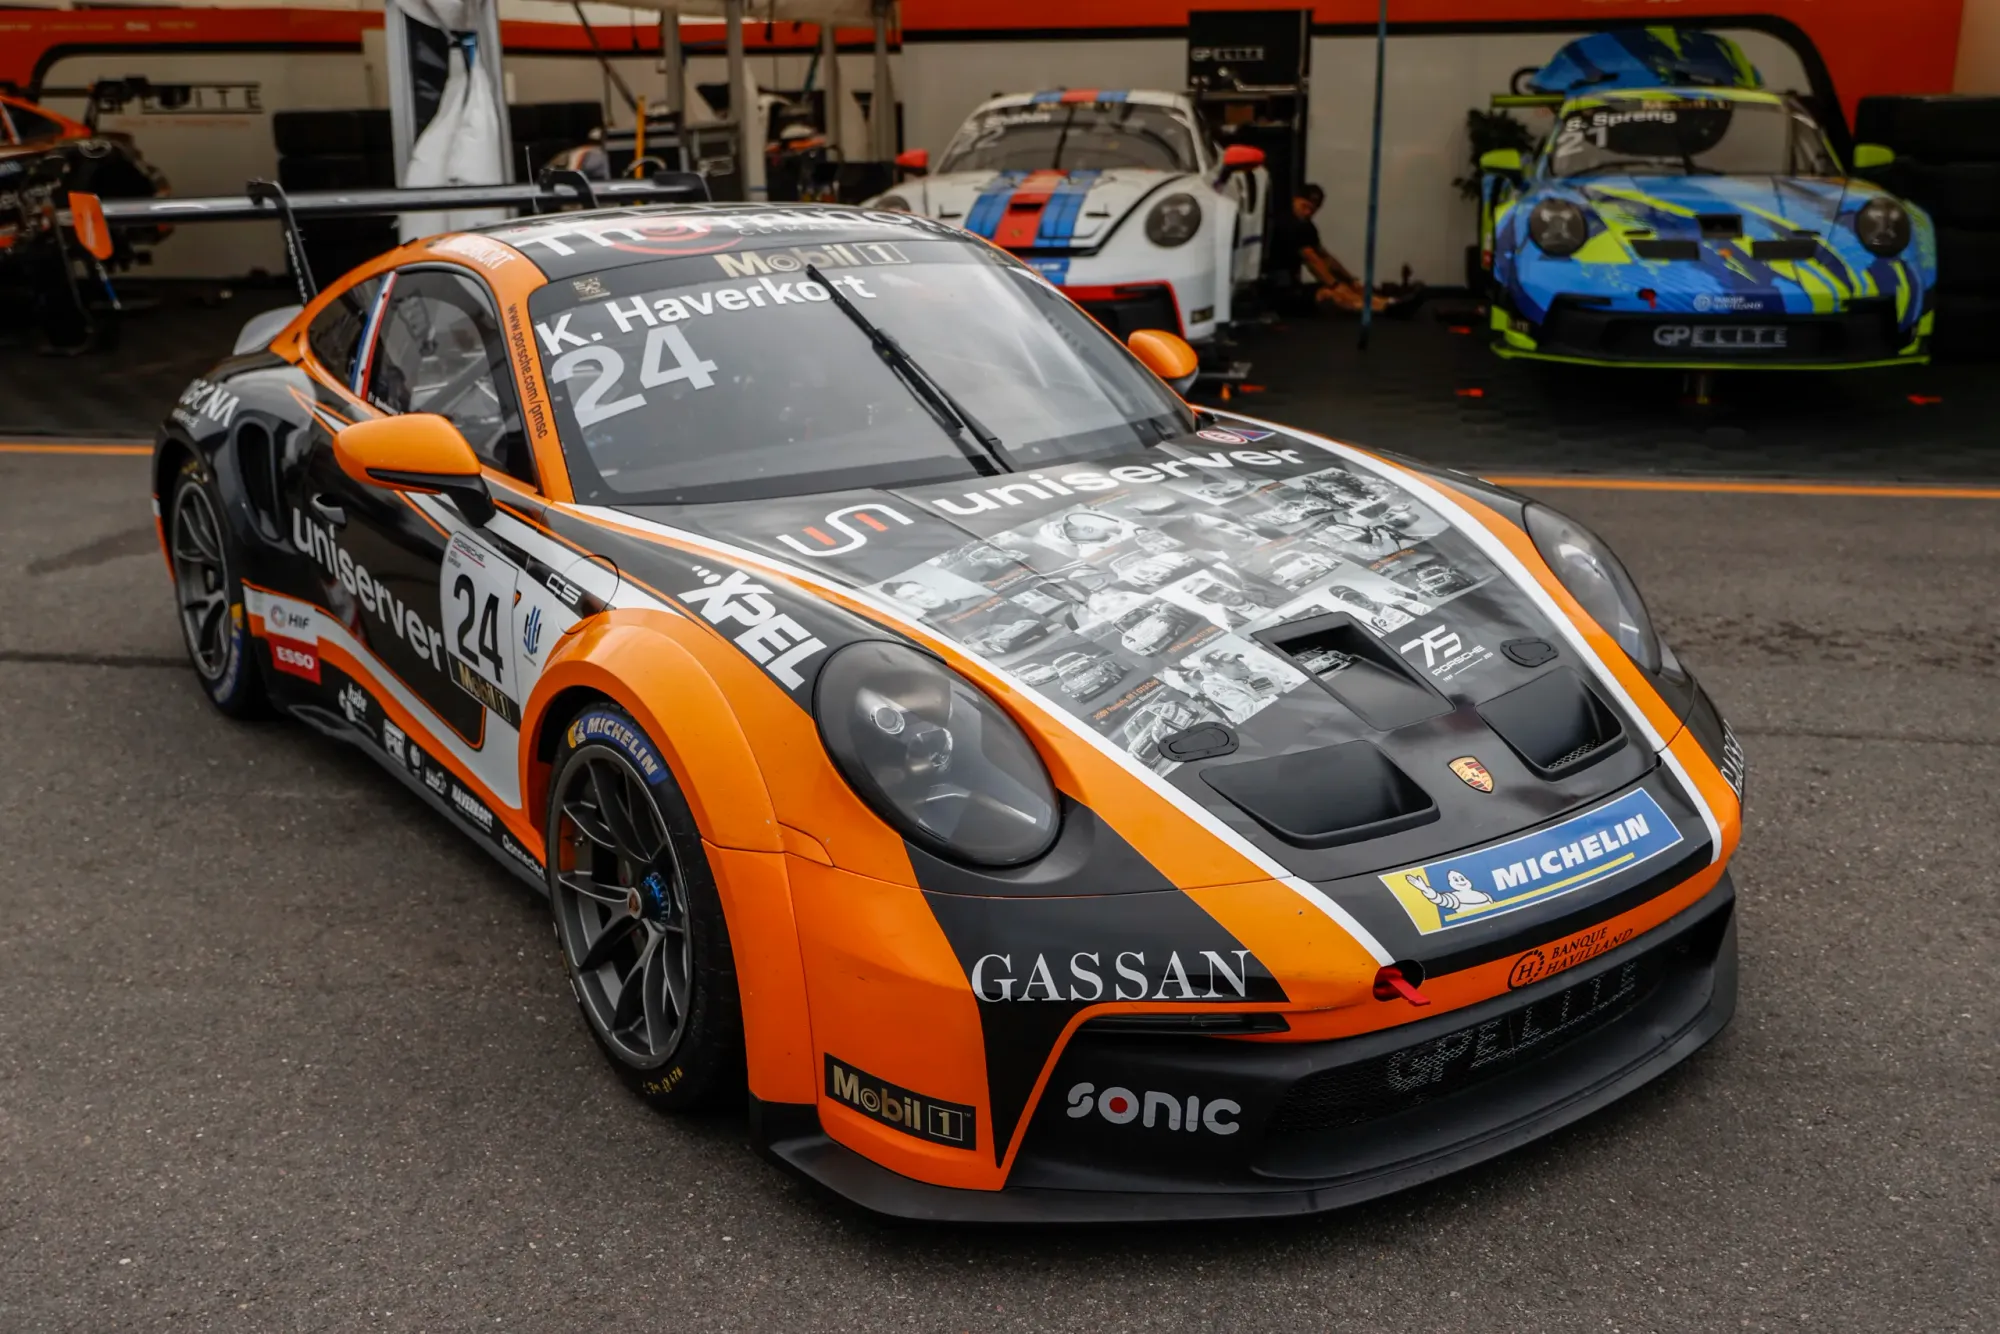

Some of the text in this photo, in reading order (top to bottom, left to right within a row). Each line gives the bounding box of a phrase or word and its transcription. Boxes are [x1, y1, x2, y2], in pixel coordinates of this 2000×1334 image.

[1556, 126, 1608, 158] 21
[1592, 110, 1678, 127] Spreng
[713, 243, 859, 278] Mobil
[534, 313, 604, 357] K.
[604, 274, 877, 334] Haverkort
[507, 303, 549, 440] www.porsche.com/pmsc
[551, 325, 718, 429] 24
[932, 448, 1305, 515] uniserver
[292, 507, 444, 673] uniserver
[288, 612, 311, 630] HIF
[453, 573, 505, 685] 24
[676, 569, 828, 692] XPEL
[1400, 624, 1462, 669] 75
[275, 645, 315, 670] ESSO
[457, 660, 497, 707] Mobil
[1431, 644, 1486, 677] PORSCHE
[586, 717, 659, 776] MICHELIN
[1491, 813, 1651, 892] MICHELIN
[1544, 928, 1634, 976] HAVILLAND
[1551, 926, 1608, 960] BANQUE
[971, 949, 1251, 1003] GASSAN
[833, 1064, 922, 1132] Mobil
